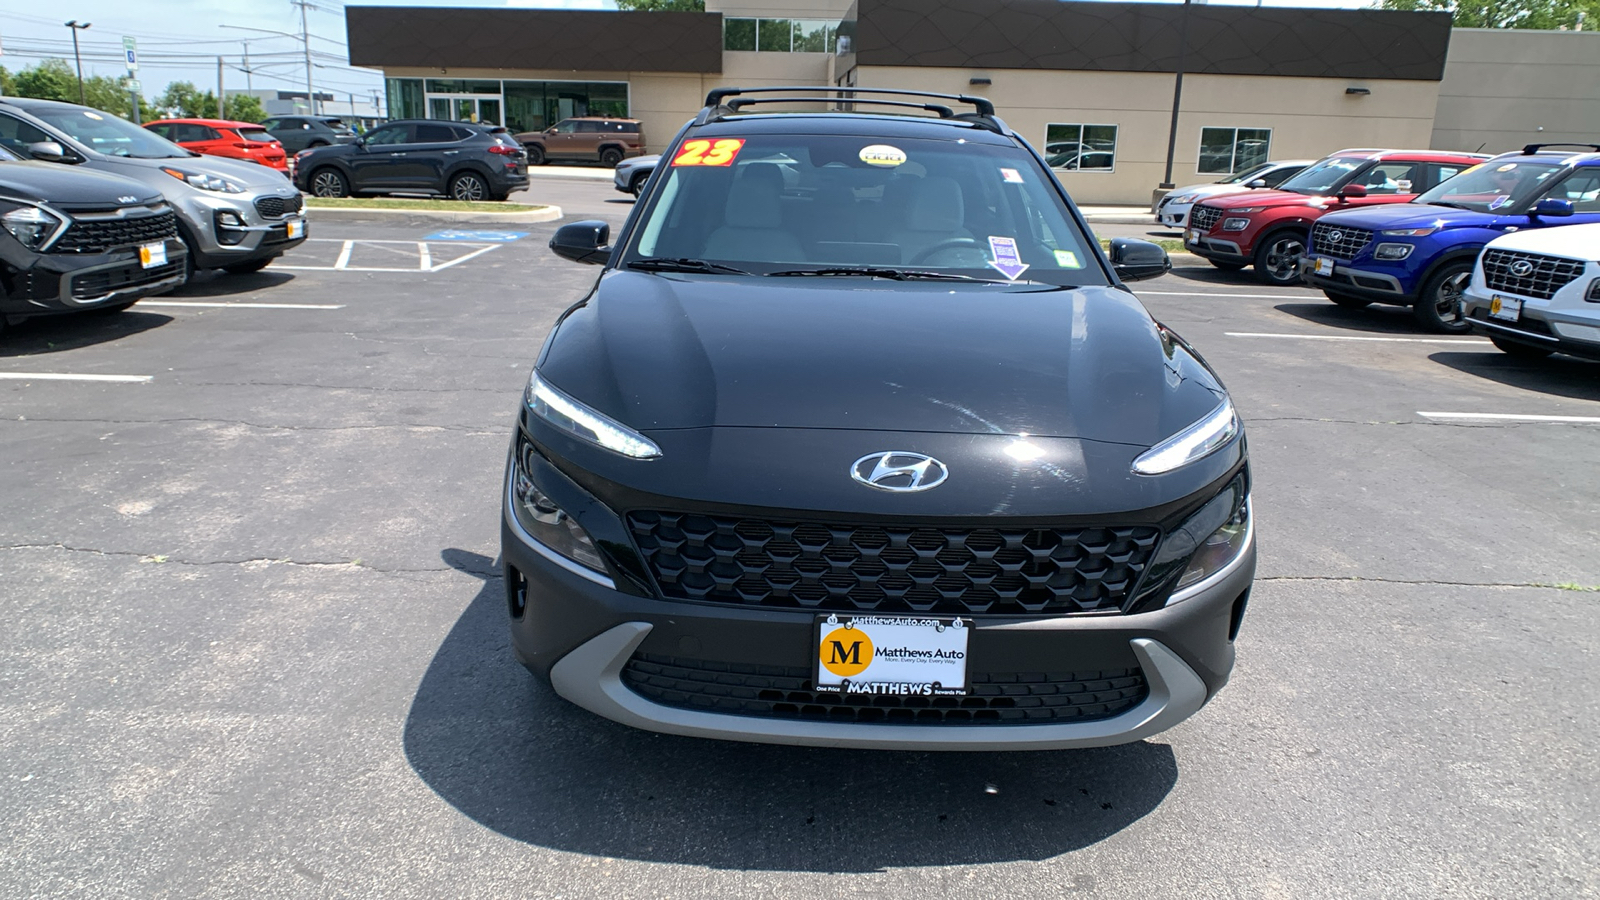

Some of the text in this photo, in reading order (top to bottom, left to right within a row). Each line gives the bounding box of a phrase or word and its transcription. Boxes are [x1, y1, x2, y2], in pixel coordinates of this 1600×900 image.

[674, 139, 741, 165] 23
[850, 616, 940, 627] MatthewsAuto.com
[827, 640, 864, 665] M
[875, 646, 965, 659] Matthews Auto
[847, 682, 932, 695] MATTHEWS
